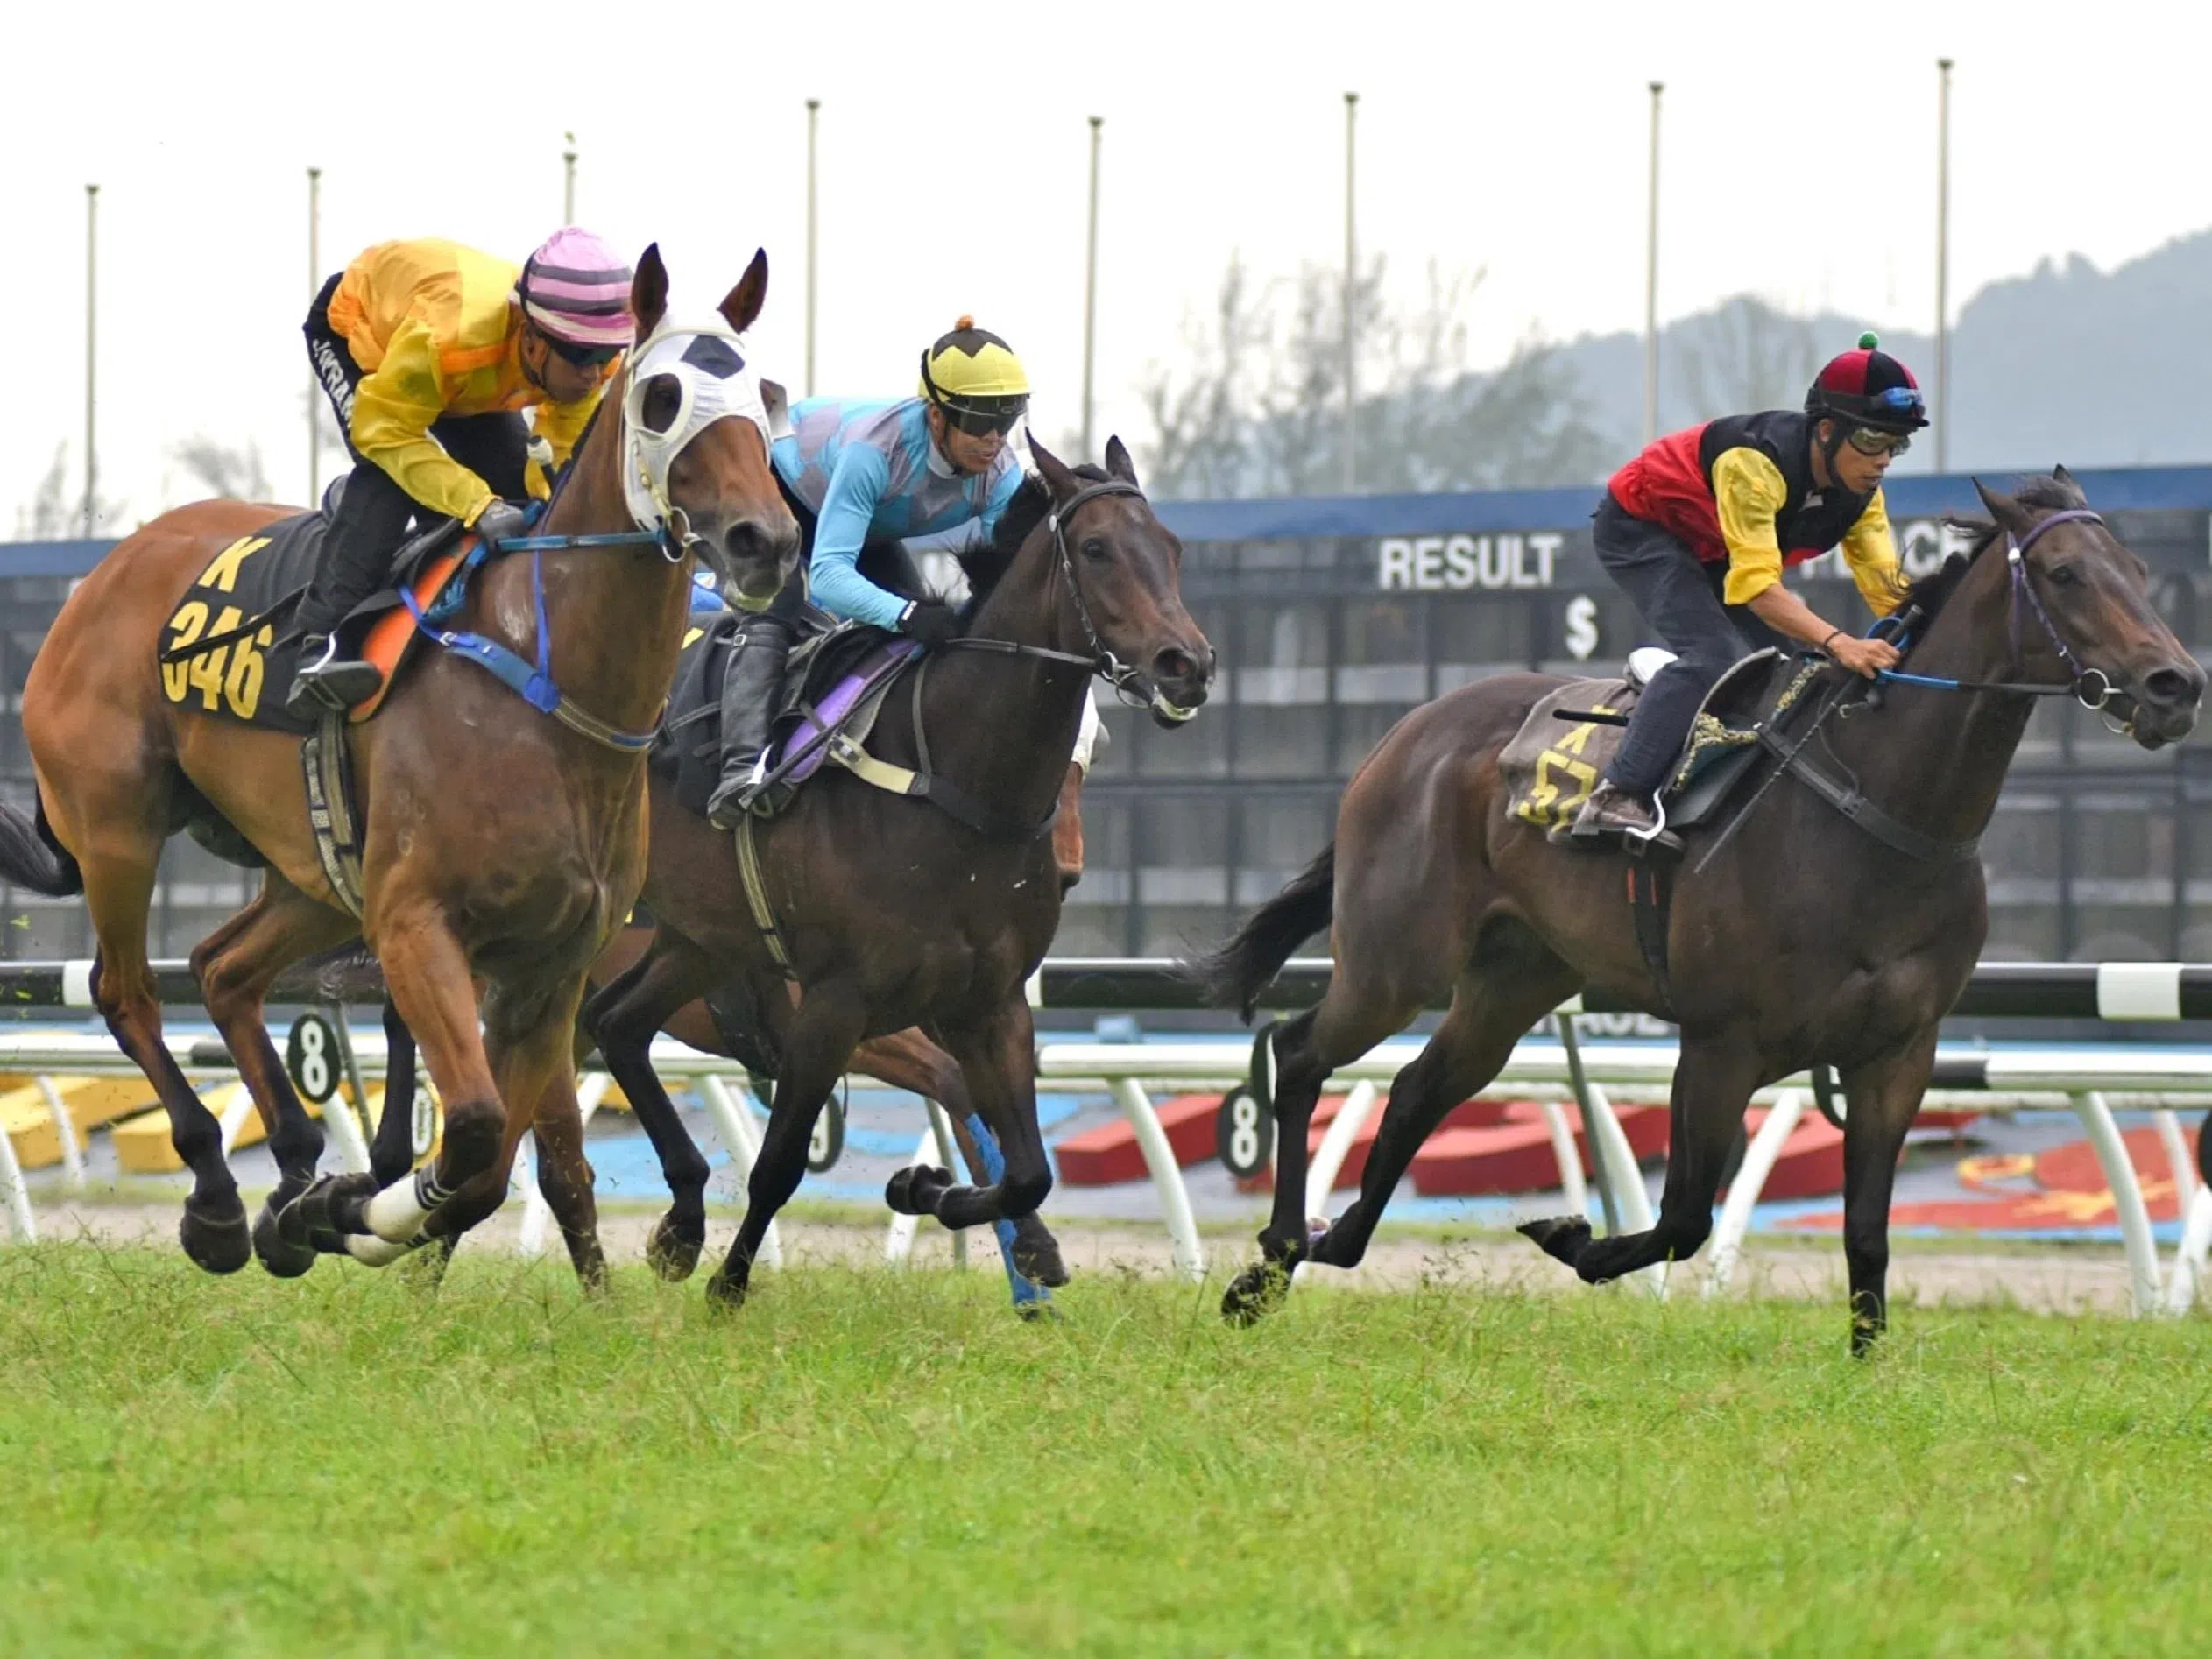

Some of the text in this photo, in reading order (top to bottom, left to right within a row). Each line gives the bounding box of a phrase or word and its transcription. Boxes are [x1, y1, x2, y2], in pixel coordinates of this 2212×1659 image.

[198, 536, 273, 593] K
[1379, 533, 1564, 589] RESULT
[161, 601, 273, 720] 346
[1565, 593, 1599, 660] $
[300, 1020, 329, 1098] 8
[1230, 1095, 1259, 1169] 8
